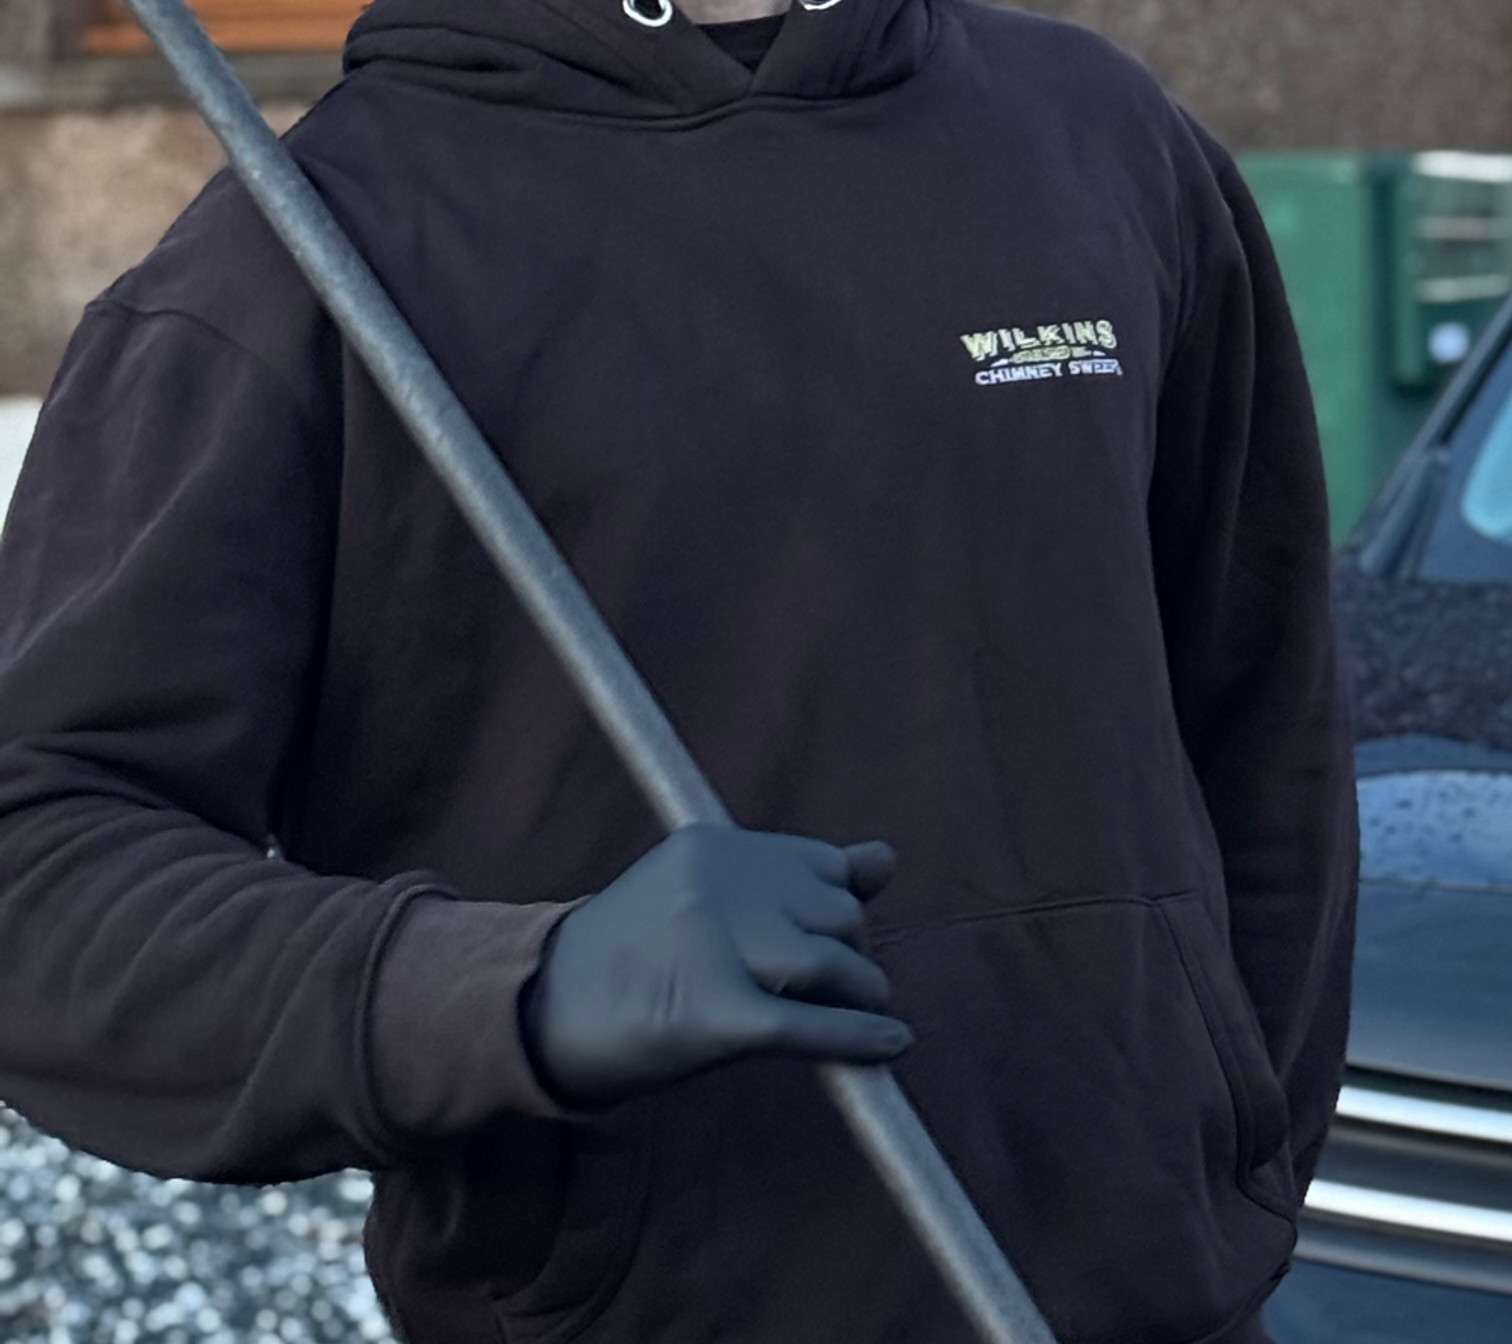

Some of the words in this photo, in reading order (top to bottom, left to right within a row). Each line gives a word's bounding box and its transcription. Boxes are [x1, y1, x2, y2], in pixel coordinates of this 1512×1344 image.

[960, 320, 1117, 362] WILKINS
[974, 362, 1063, 385] CHIMNEY
[1068, 359, 1123, 375] SWEEP
